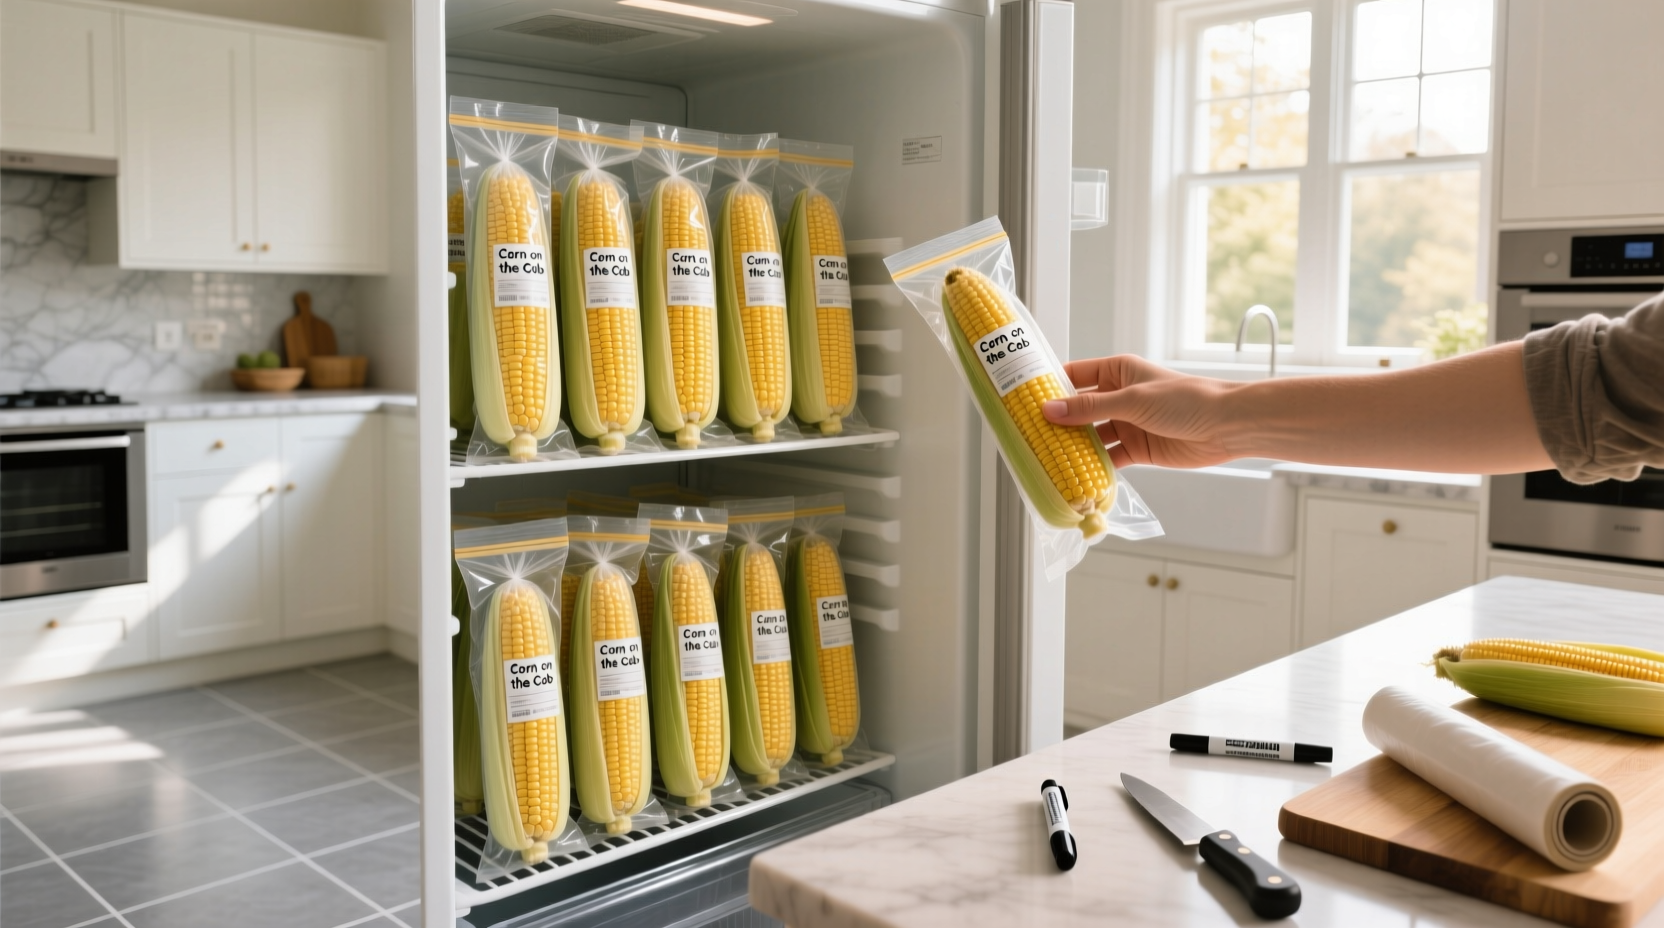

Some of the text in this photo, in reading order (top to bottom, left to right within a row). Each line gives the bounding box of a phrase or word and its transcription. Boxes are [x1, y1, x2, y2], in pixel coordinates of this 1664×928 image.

[498, 248, 543, 261] Corn on
[499, 261, 519, 274] the
[589, 264, 609, 276] the
[672, 264, 691, 276] the
[980, 327, 1025, 353] Corn on
[986, 337, 1030, 365] the Cob
[600, 644, 626, 656] Corn
[510, 661, 553, 675] Corn on
[600, 658, 618, 669] the
[511, 673, 553, 690] the Cob
